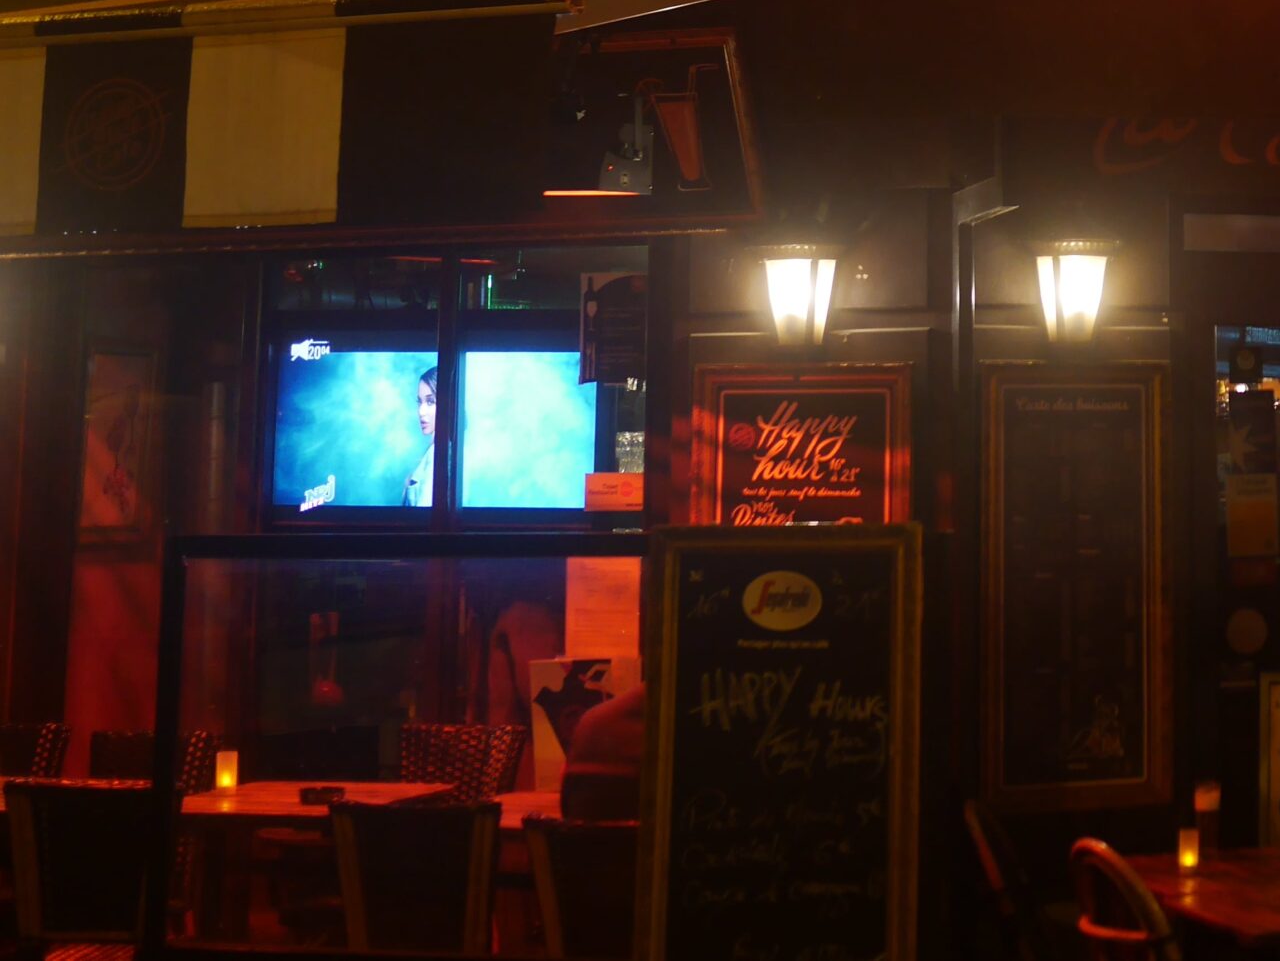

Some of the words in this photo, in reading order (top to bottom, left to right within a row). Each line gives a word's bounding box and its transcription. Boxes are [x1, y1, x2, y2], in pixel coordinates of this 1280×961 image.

[751, 439, 826, 482] hour
[756, 400, 858, 462] Happy
[689, 665, 803, 760] HAPPY
